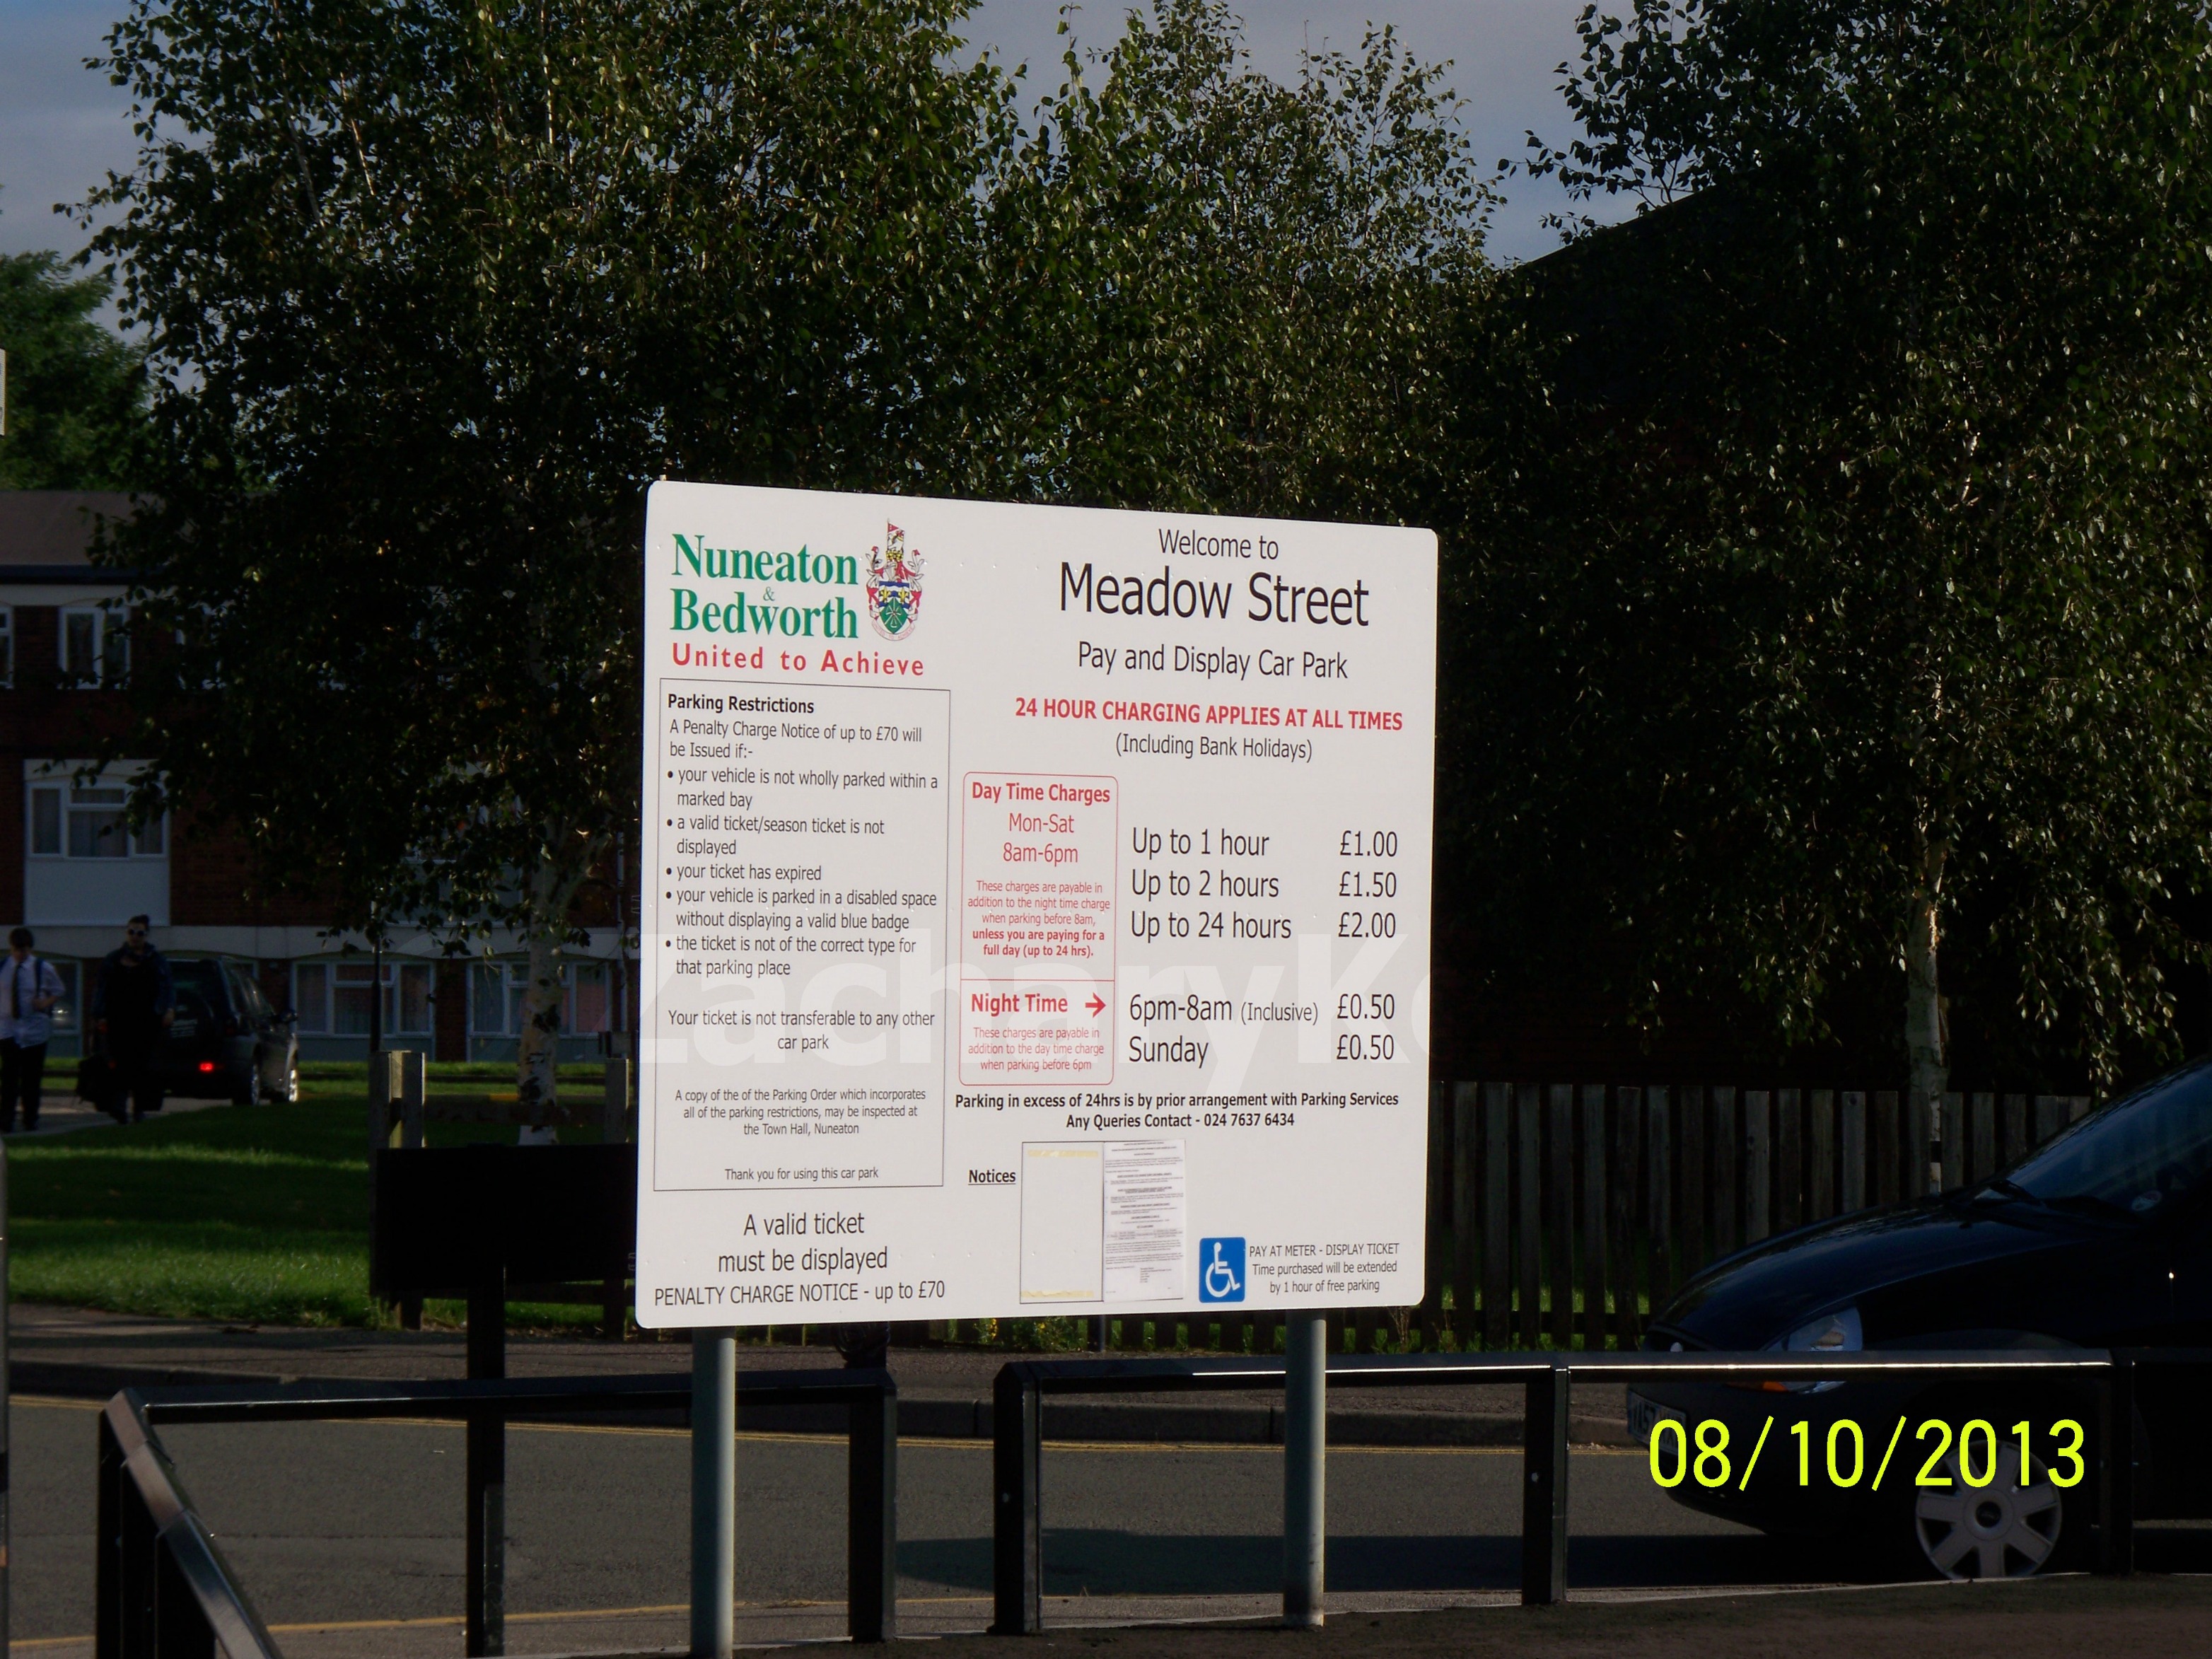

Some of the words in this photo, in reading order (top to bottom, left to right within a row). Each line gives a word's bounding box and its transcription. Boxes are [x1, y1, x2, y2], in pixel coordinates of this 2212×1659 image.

[1158, 528, 1252, 559] Welcome
[1259, 535, 1279, 560] to
[672, 534, 858, 586] Nuneaton
[762, 586, 776, 602] &
[1061, 561, 1233, 619] Meadow
[1248, 571, 1369, 627] Street
[670, 588, 858, 639] Bedworth
[673, 642, 763, 669] United
[780, 651, 807, 671] to
[820, 649, 924, 676] Achieve
[1079, 641, 1117, 675] Pay
[1124, 644, 1165, 671] and
[1175, 645, 1251, 681] Display
[1259, 649, 1295, 676] Car
[1303, 651, 1348, 679] Park
[668, 693, 723, 714] Parking
[728, 696, 815, 714] Restrictions
[1015, 697, 1038, 717] 24
[1044, 698, 1098, 719] HOUR
[1102, 701, 1200, 723] CHARGING
[1205, 705, 1281, 726] APPLIES
[1284, 708, 1308, 728] AT
[1312, 709, 1344, 729] ALL
[1348, 710, 1403, 731] TIMES
[670, 718, 680, 734] A
[683, 719, 729, 739] Penalty
[733, 721, 777, 741] Charge
[781, 723, 820, 739] Notice
[823, 723, 837, 740] of
[840, 728, 856, 743] up
[859, 726, 872, 740] to
[875, 726, 899, 742] £70
[902, 727, 921, 743] will
[670, 740, 686, 757] be
[689, 742, 730, 759] Issued
[735, 743, 753, 759] if:-
[1116, 732, 1194, 759] (Including
[1200, 736, 1238, 757] Bank
[1243, 738, 1312, 764] Holidays)
[677, 769, 708, 785] your
[711, 767, 756, 784] vehicle
[759, 768, 770, 784] is
[774, 770, 796, 785] not
[798, 769, 839, 790] wholly
[843, 771, 885, 790] parked
[890, 772, 926, 788] within
[931, 777, 938, 789] a
[677, 790, 725, 807] marked
[730, 791, 753, 811] bay
[972, 781, 1002, 804] Day
[1006, 782, 1044, 801] Time
[1048, 784, 1110, 807] Charges
[1009, 813, 1075, 834] Mon-Sat
[1003, 842, 1078, 868] 8am-6pm
[1133, 827, 1162, 861] Up
[1170, 829, 1192, 855] to
[1201, 829, 1211, 855] 1
[1221, 828, 1270, 856] hour
[1339, 830, 1398, 858] £1.00
[677, 866, 706, 882] your
[710, 863, 745, 880] ticket
[749, 863, 772, 880] has
[775, 865, 822, 884] expired
[1132, 868, 1161, 902] Up
[1169, 871, 1190, 896] to
[1199, 870, 1211, 896] 2
[1220, 869, 1279, 898] hours
[1339, 871, 1397, 898] £1.50
[976, 880, 1003, 892] These
[1005, 880, 1040, 895] charges
[1042, 883, 1056, 893] are
[1059, 882, 1093, 895] payable
[1095, 882, 1102, 893] in
[1131, 910, 1160, 944] Up
[1168, 912, 1189, 938] to
[1198, 911, 1224, 938] 24
[1233, 911, 1291, 939] hours
[1338, 912, 1396, 938] £2.00
[983, 943, 1000, 955] full
[1002, 944, 1020, 958] day
[1023, 944, 1040, 959] (up
[1042, 945, 1053, 956] to
[1056, 945, 1069, 956] 24
[1071, 945, 1094, 959] hrs).
[972, 993, 1020, 1018] Night
[1024, 993, 1068, 1013] Time
[1130, 994, 1232, 1028] 6pm-8am
[1241, 1001, 1318, 1026] (Inclusive)
[1337, 994, 1395, 1020] £0.50
[1129, 1035, 1209, 1069] Sunday
[1336, 1034, 1395, 1061] £0.50
[675, 1089, 682, 1101] A
[685, 1091, 708, 1104] copy
[710, 1088, 721, 1101] of
[723, 1089, 739, 1101] the
[741, 1088, 752, 1101] of
[754, 1088, 770, 1101] the
[772, 1088, 808, 1104] Parking
[810, 1088, 837, 1101] Order
[839, 1088, 867, 1100] which
[870, 1088, 926, 1102] incorporates
[955, 1093, 1004, 1111] Parking
[1008, 1093, 1020, 1108] in
[1023, 1096, 1066, 1107] excess
[1069, 1093, 1083, 1107] of
[1085, 1093, 1121, 1107] 24hrs
[1124, 1093, 1134, 1107] is
[1138, 1093, 1153, 1110] by
[1156, 1093, 1186, 1110] prior
[1189, 1093, 1268, 1110] arrangement
[1271, 1092, 1298, 1106] with
[1301, 1092, 1346, 1109] Parking
[1349, 1092, 1399, 1106] Services
[1066, 1114, 1090, 1131] Any
[1093, 1113, 1141, 1131] Queries
[1144, 1114, 1192, 1127] Contact
[1204, 1113, 1228, 1127] 024
[1230, 1113, 1261, 1127] 7637
[1264, 1112, 1295, 1127] 6434
[724, 1168, 755, 1180] Thank
[757, 1170, 774, 1182] you
[776, 1168, 791, 1180] for
[793, 1168, 818, 1182] using
[821, 1167, 839, 1180] this
[840, 1169, 856, 1179] car
[858, 1166, 879, 1181] park
[968, 1168, 1016, 1183] Notices
[743, 1213, 757, 1236] A
[763, 1212, 807, 1236] valid
[813, 1211, 865, 1235] ticket
[718, 1250, 766, 1273] must
[772, 1248, 795, 1271] be
[801, 1245, 887, 1276] displayed
[1250, 1245, 1267, 1257] PAY
[1269, 1245, 1283, 1257] AT
[1285, 1244, 1317, 1257] METER
[1326, 1243, 1365, 1256] DISPLAY
[1366, 1242, 1400, 1255] TICKET
[1252, 1264, 1275, 1276] Time
[1277, 1262, 1323, 1278] purchased
[1325, 1262, 1341, 1274] will
[1343, 1262, 1355, 1274] be
[1356, 1260, 1397, 1274] extended
[655, 1286, 726, 1306] PENALTY
[730, 1284, 794, 1304] CHARGE
[800, 1283, 858, 1302] NOTICE
[875, 1286, 894, 1304] up
[898, 1282, 914, 1299] to
[918, 1280, 945, 1298] £70
